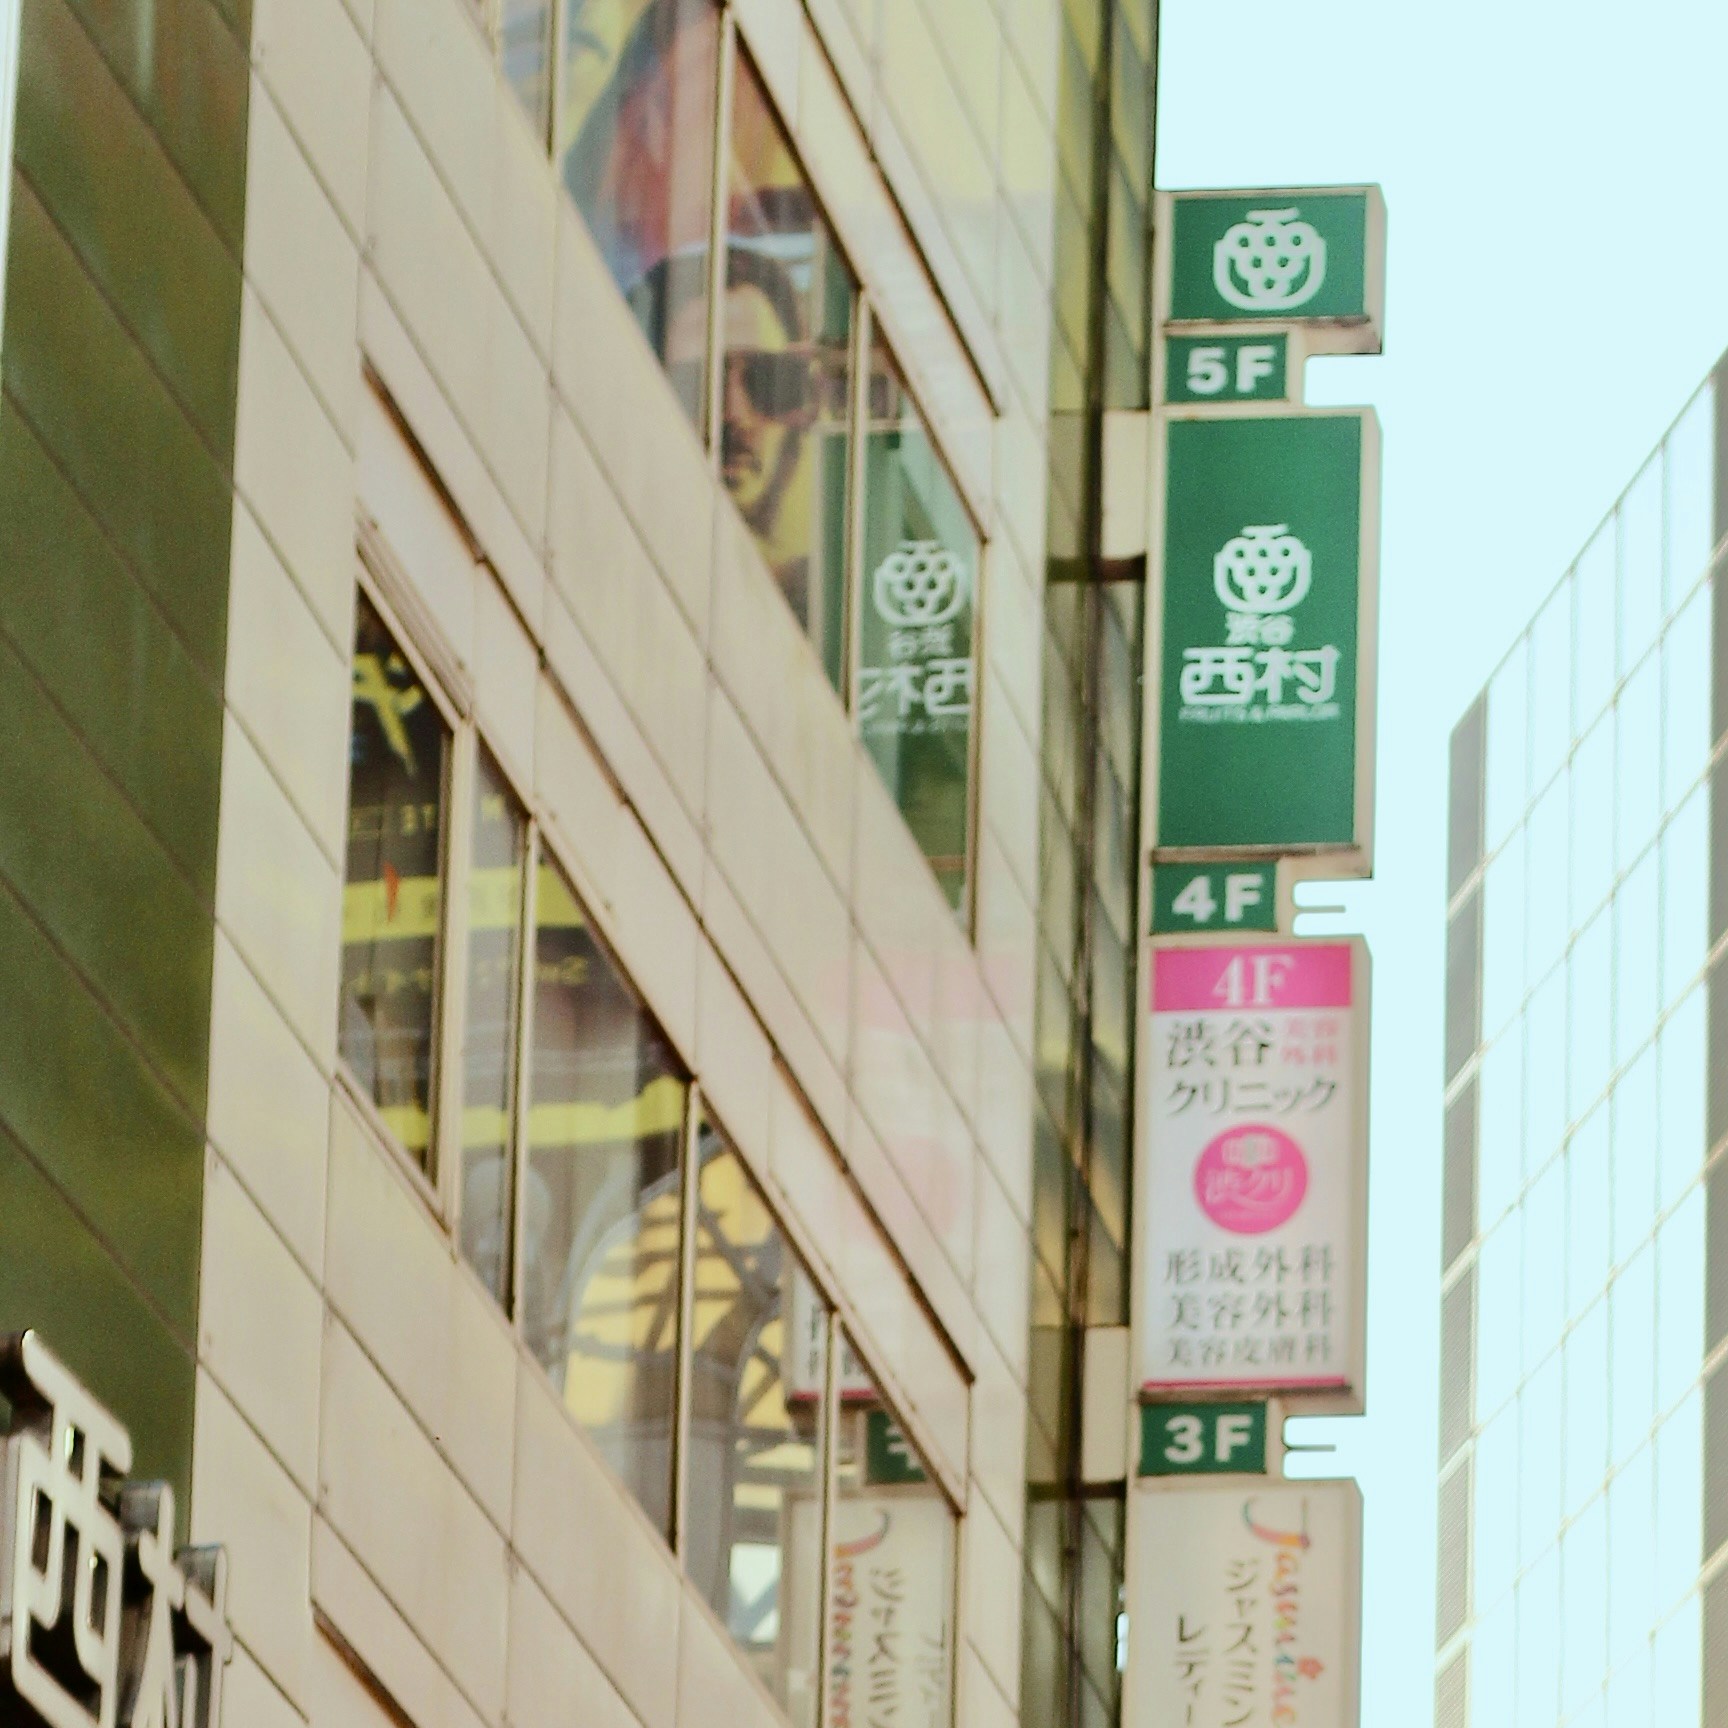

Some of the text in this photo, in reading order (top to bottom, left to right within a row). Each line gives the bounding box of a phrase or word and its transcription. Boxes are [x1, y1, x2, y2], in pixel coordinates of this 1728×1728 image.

[1186, 345, 1277, 394] 5F
[1179, 644, 1340, 705] 西村
[1172, 874, 1263, 923] 4F
[1212, 953, 1294, 1007] 4F
[1167, 1018, 1274, 1070] 渋谷
[1166, 1078, 1340, 1117] クリニック
[1165, 1245, 1336, 1288] 形成外科
[1166, 1289, 1336, 1332] 美容外科
[1164, 1414, 1253, 1464] 3F
[1223, 1557, 1260, 1728] ジャスミン
